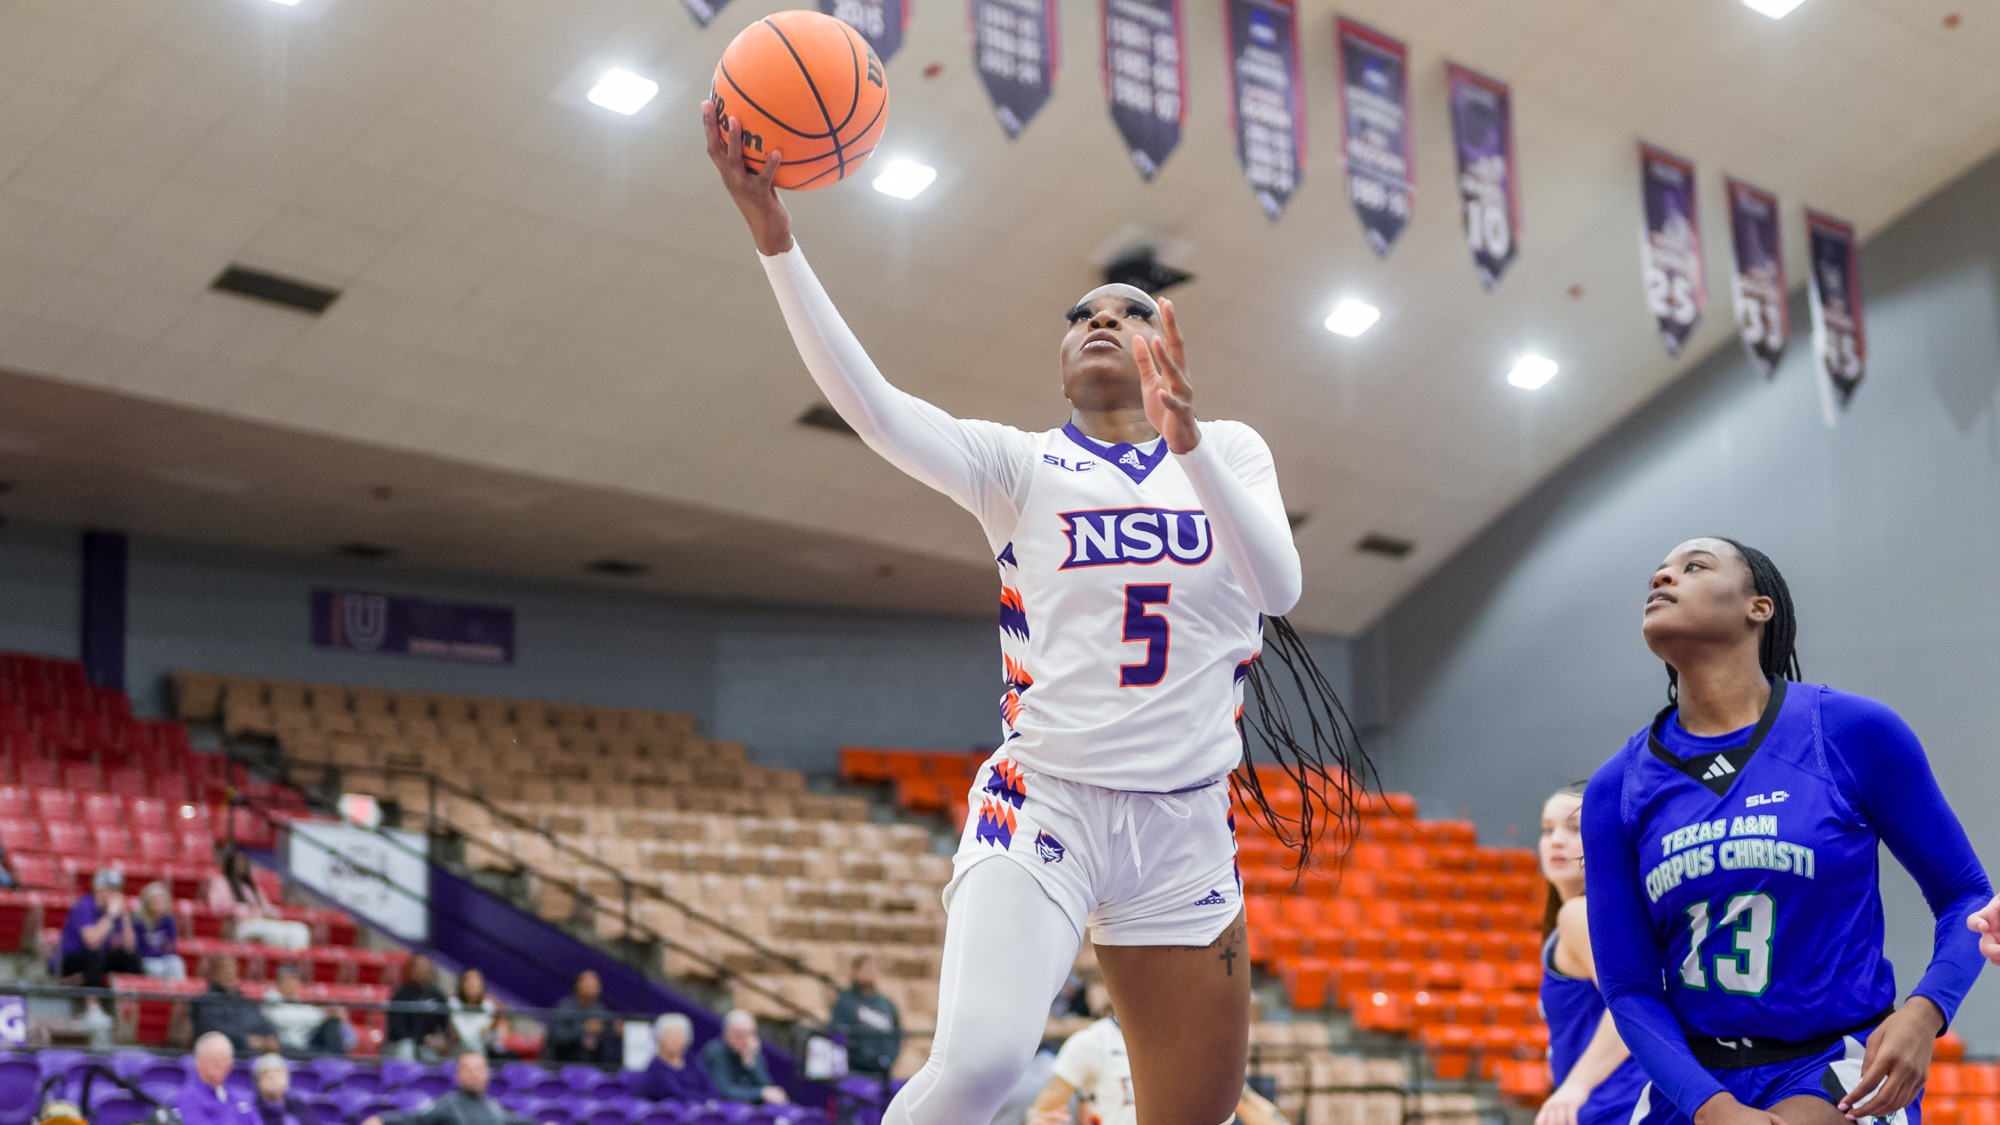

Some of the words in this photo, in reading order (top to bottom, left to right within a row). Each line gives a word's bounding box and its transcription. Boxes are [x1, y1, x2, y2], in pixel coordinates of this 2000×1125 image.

[1043, 454, 1097, 472] SLC
[1071, 511, 1209, 562] NSU
[1119, 583, 1172, 688] 5
[1745, 790, 1790, 808] SLC
[1661, 818, 1727, 857] TEXAS
[1729, 815, 1778, 838] A&M
[1645, 844, 1715, 904] CORPUS
[1719, 839, 1815, 880] CHRISTI
[1678, 890, 1777, 998] 13
